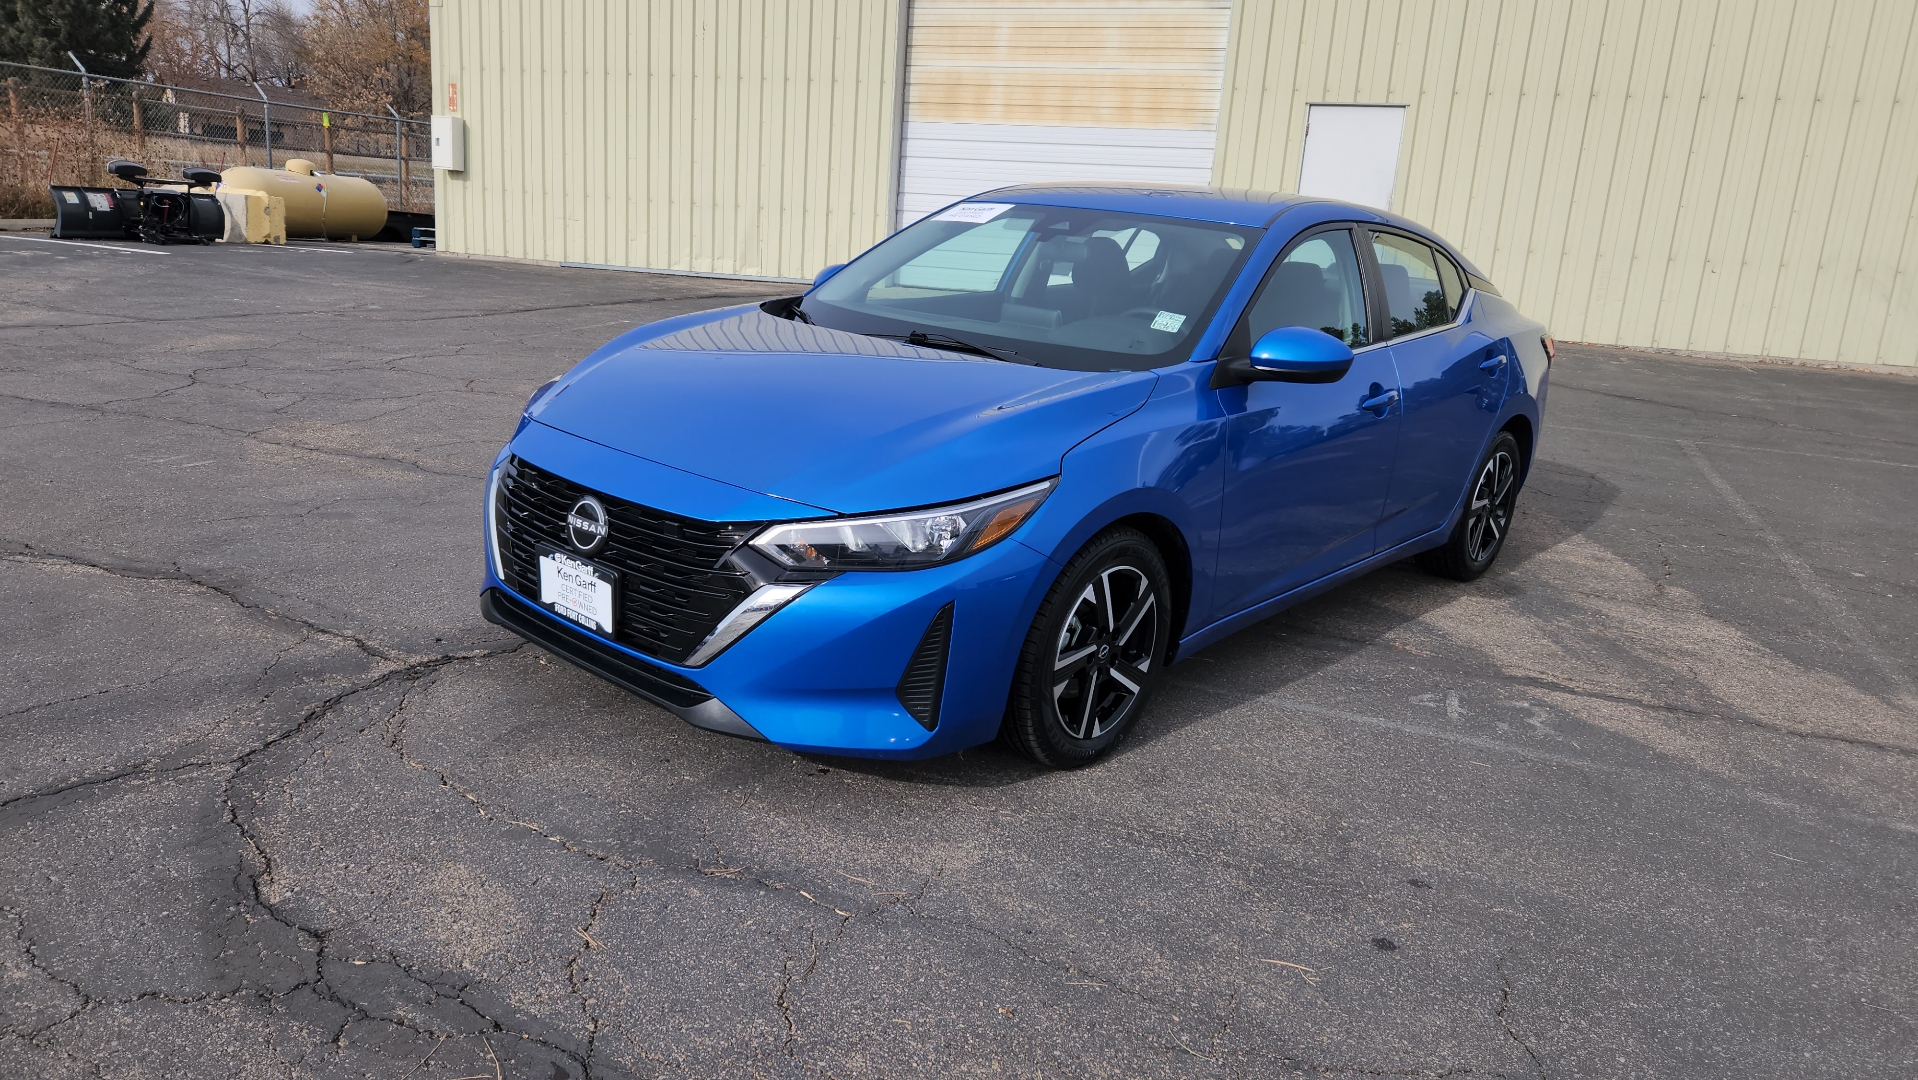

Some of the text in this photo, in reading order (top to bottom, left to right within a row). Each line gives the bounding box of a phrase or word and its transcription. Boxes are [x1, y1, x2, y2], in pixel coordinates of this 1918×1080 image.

[567, 514, 606, 536] NISSAN
[557, 565, 597, 594] Ken Garff
[560, 583, 594, 604] CERTIFIED
